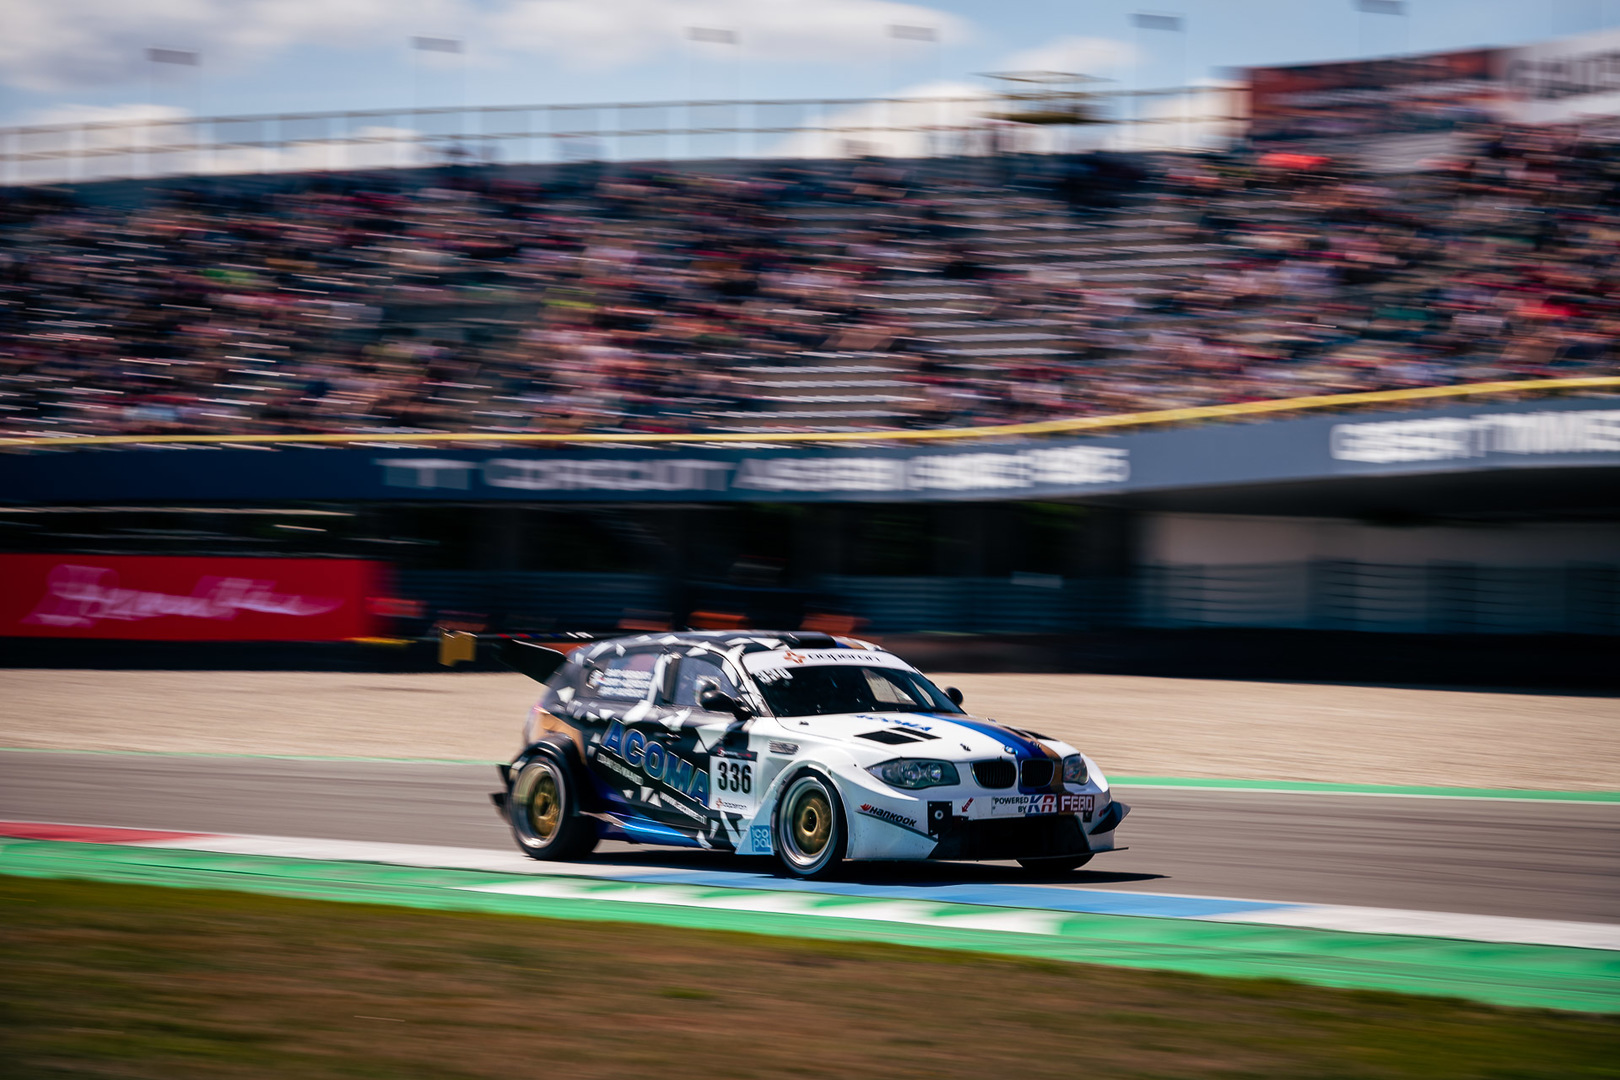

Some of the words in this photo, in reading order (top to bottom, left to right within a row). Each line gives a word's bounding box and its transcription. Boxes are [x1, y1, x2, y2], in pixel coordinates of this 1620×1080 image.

[600, 717, 710, 811] ACOMA
[718, 761, 752, 794] 336
[994, 795, 1030, 805] POWERED
[1018, 805, 1027, 813] BY
